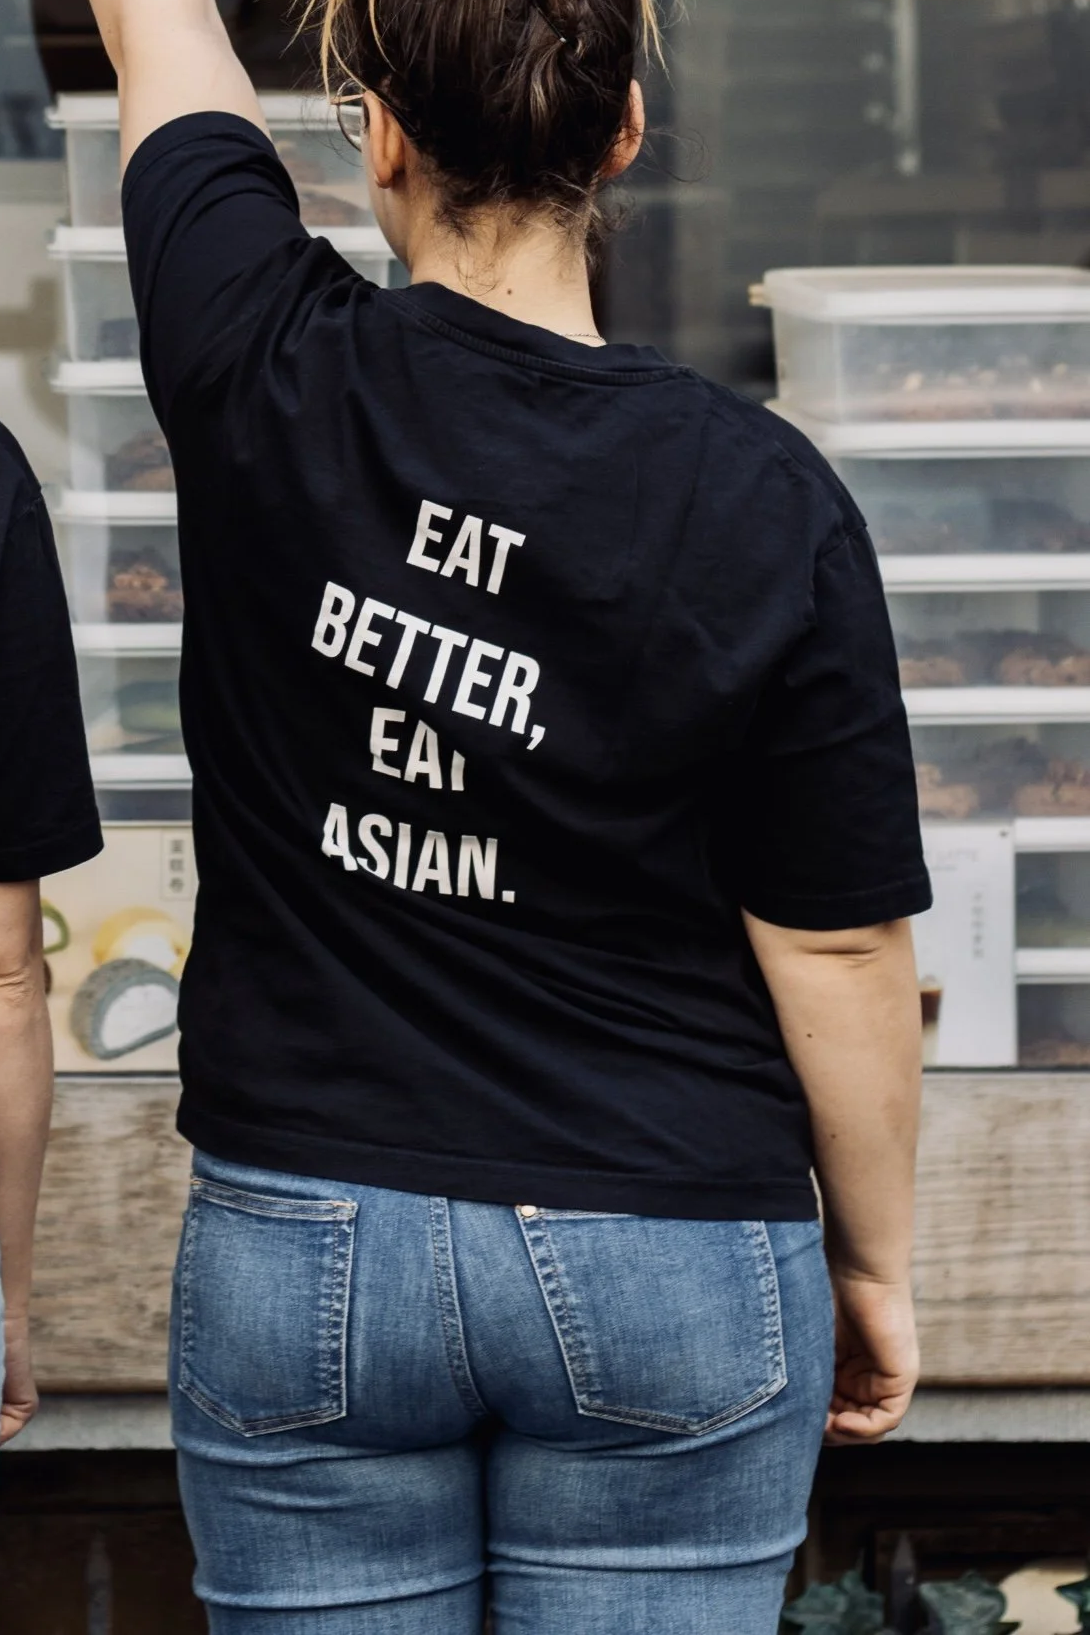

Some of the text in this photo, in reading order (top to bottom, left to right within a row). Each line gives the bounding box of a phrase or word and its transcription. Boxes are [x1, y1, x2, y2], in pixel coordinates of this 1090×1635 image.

[406, 500, 526, 594] EAT
[312, 581, 545, 750] BETTER,
[322, 803, 515, 902] ASIAN.
